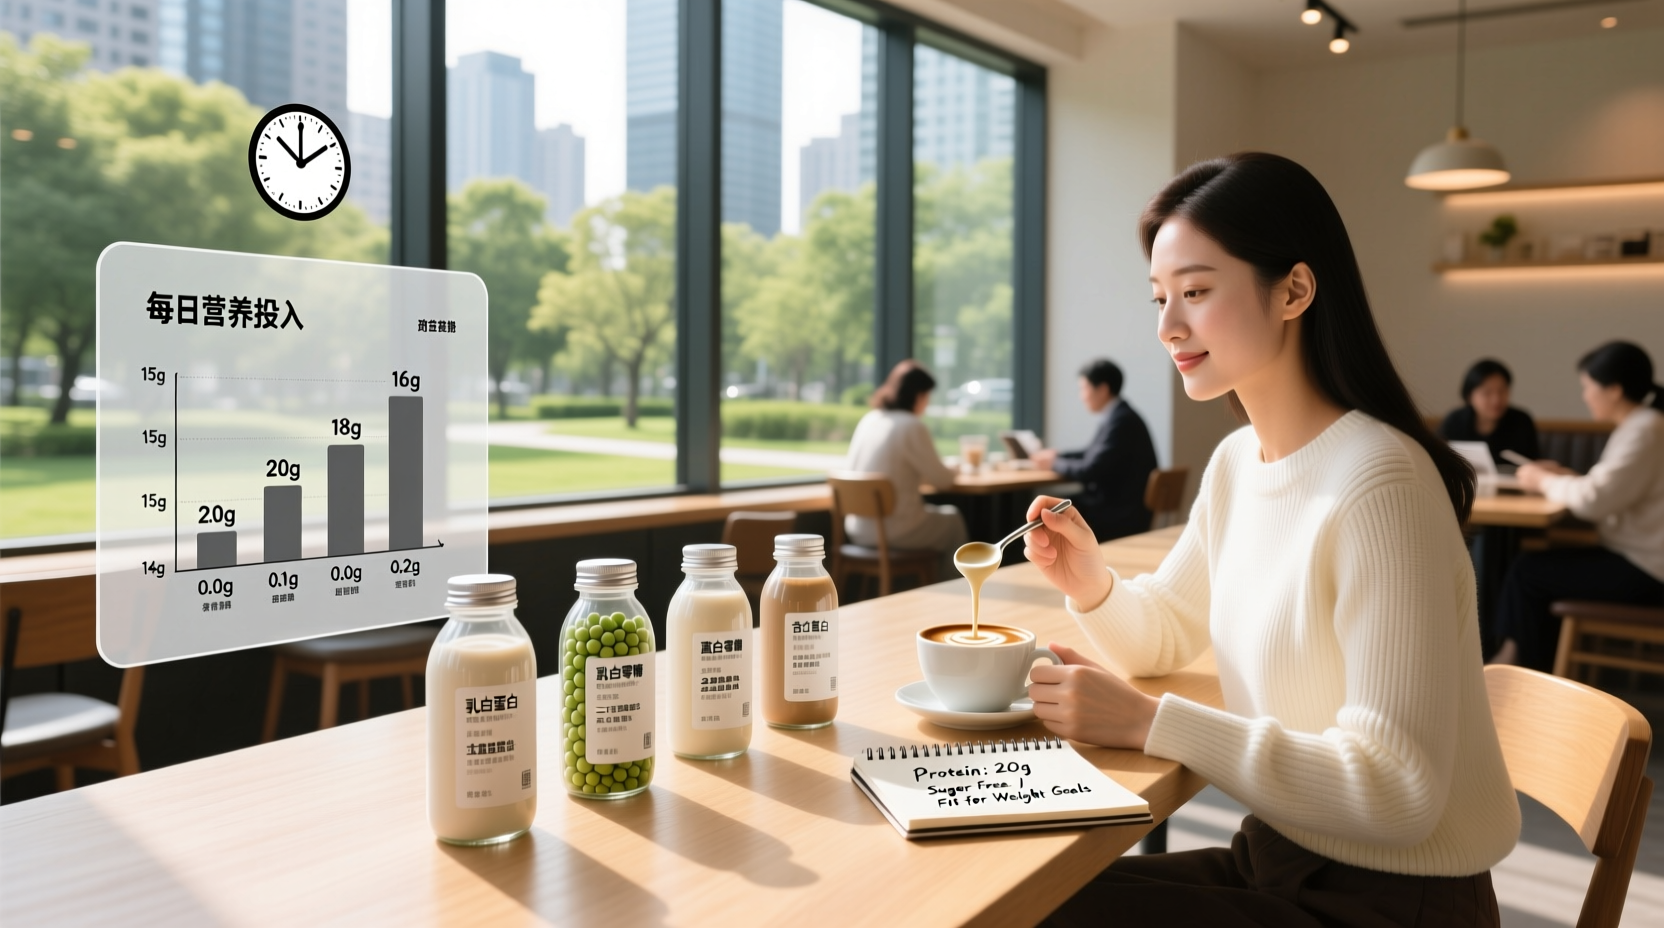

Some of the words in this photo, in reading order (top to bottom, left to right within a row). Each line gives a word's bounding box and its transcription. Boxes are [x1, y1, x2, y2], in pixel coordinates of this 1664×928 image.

[146, 290, 304, 331] 每日营养投入
[142, 366, 166, 386] 15g
[392, 370, 421, 393] 16g
[142, 429, 167, 448] 15g
[331, 417, 362, 440] 18g
[266, 458, 301, 482] 20g
[141, 493, 167, 512] 15g
[198, 504, 236, 528] 2.0g
[142, 560, 165, 579] 14g
[330, 565, 362, 583] 0.0g
[390, 558, 420, 577] 0.2g
[197, 578, 233, 598] 0.0g
[268, 571, 299, 590] 0.1g
[913, 765, 988, 783] Protein:
[994, 761, 1031, 776] 20g
[964, 795, 987, 807] for
